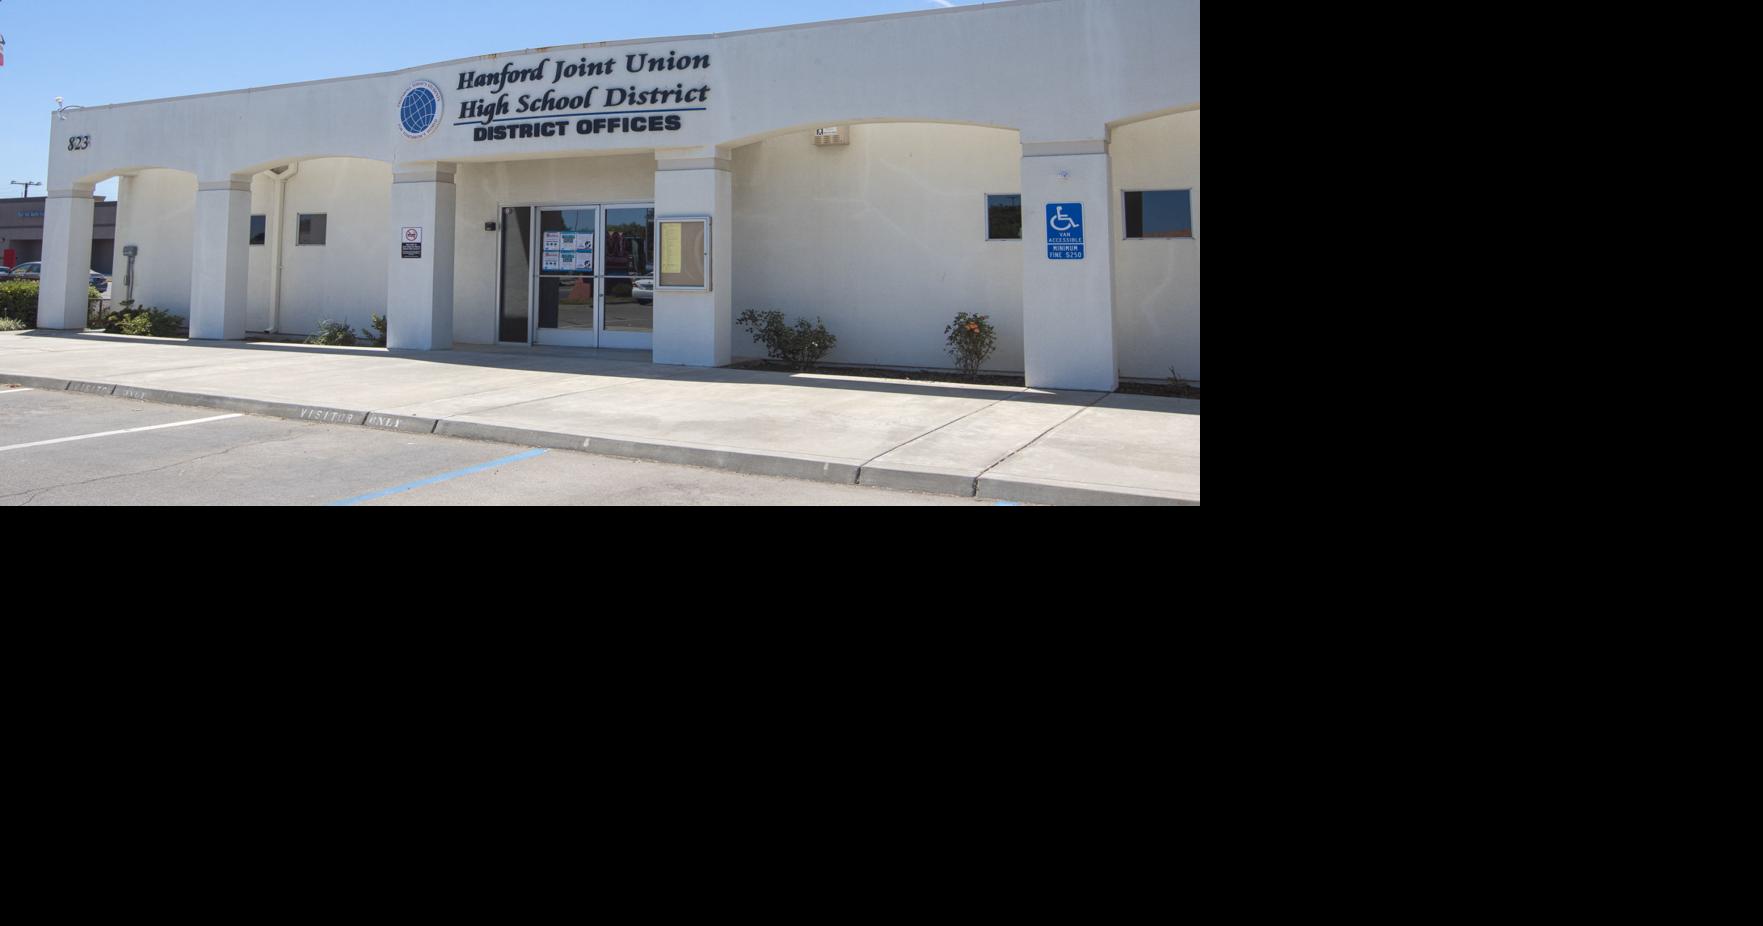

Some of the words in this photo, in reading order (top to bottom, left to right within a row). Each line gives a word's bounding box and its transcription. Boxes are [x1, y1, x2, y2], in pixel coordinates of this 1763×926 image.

[456, 58, 551, 94] Hanford
[552, 57, 616, 84] Joint
[625, 50, 711, 73] Union
[458, 93, 509, 125] High
[515, 86, 599, 113] School
[603, 83, 711, 107] District
[473, 121, 569, 142] DISTRICT
[576, 114, 681, 135] OFFICES
[67, 135, 89, 151] 823
[299, 407, 354, 423] VISITOR
